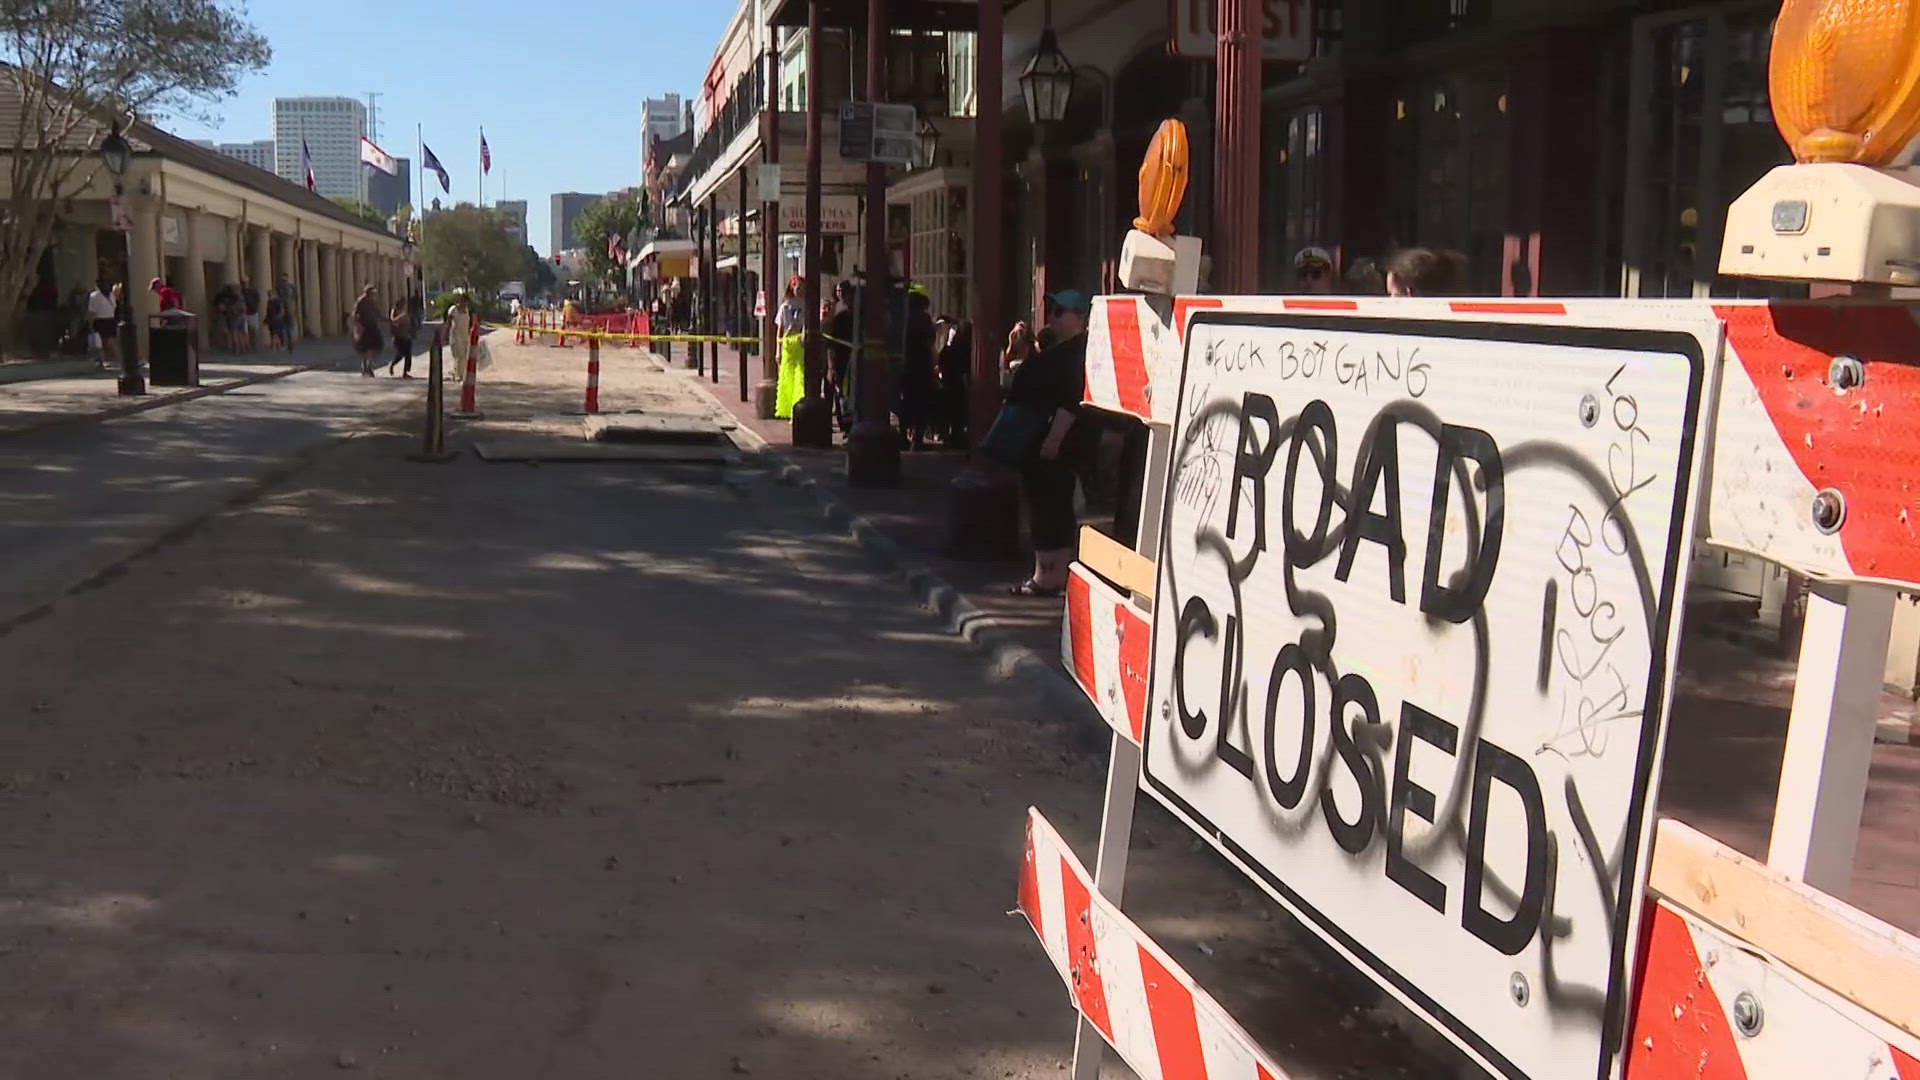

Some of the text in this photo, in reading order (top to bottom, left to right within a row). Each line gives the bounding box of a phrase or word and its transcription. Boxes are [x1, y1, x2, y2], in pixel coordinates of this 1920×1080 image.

[1213, 339, 1432, 398] FUCK BOY GANG
[1226, 391, 1505, 623] ROAD
[1175, 596, 1548, 956] CLOSED
